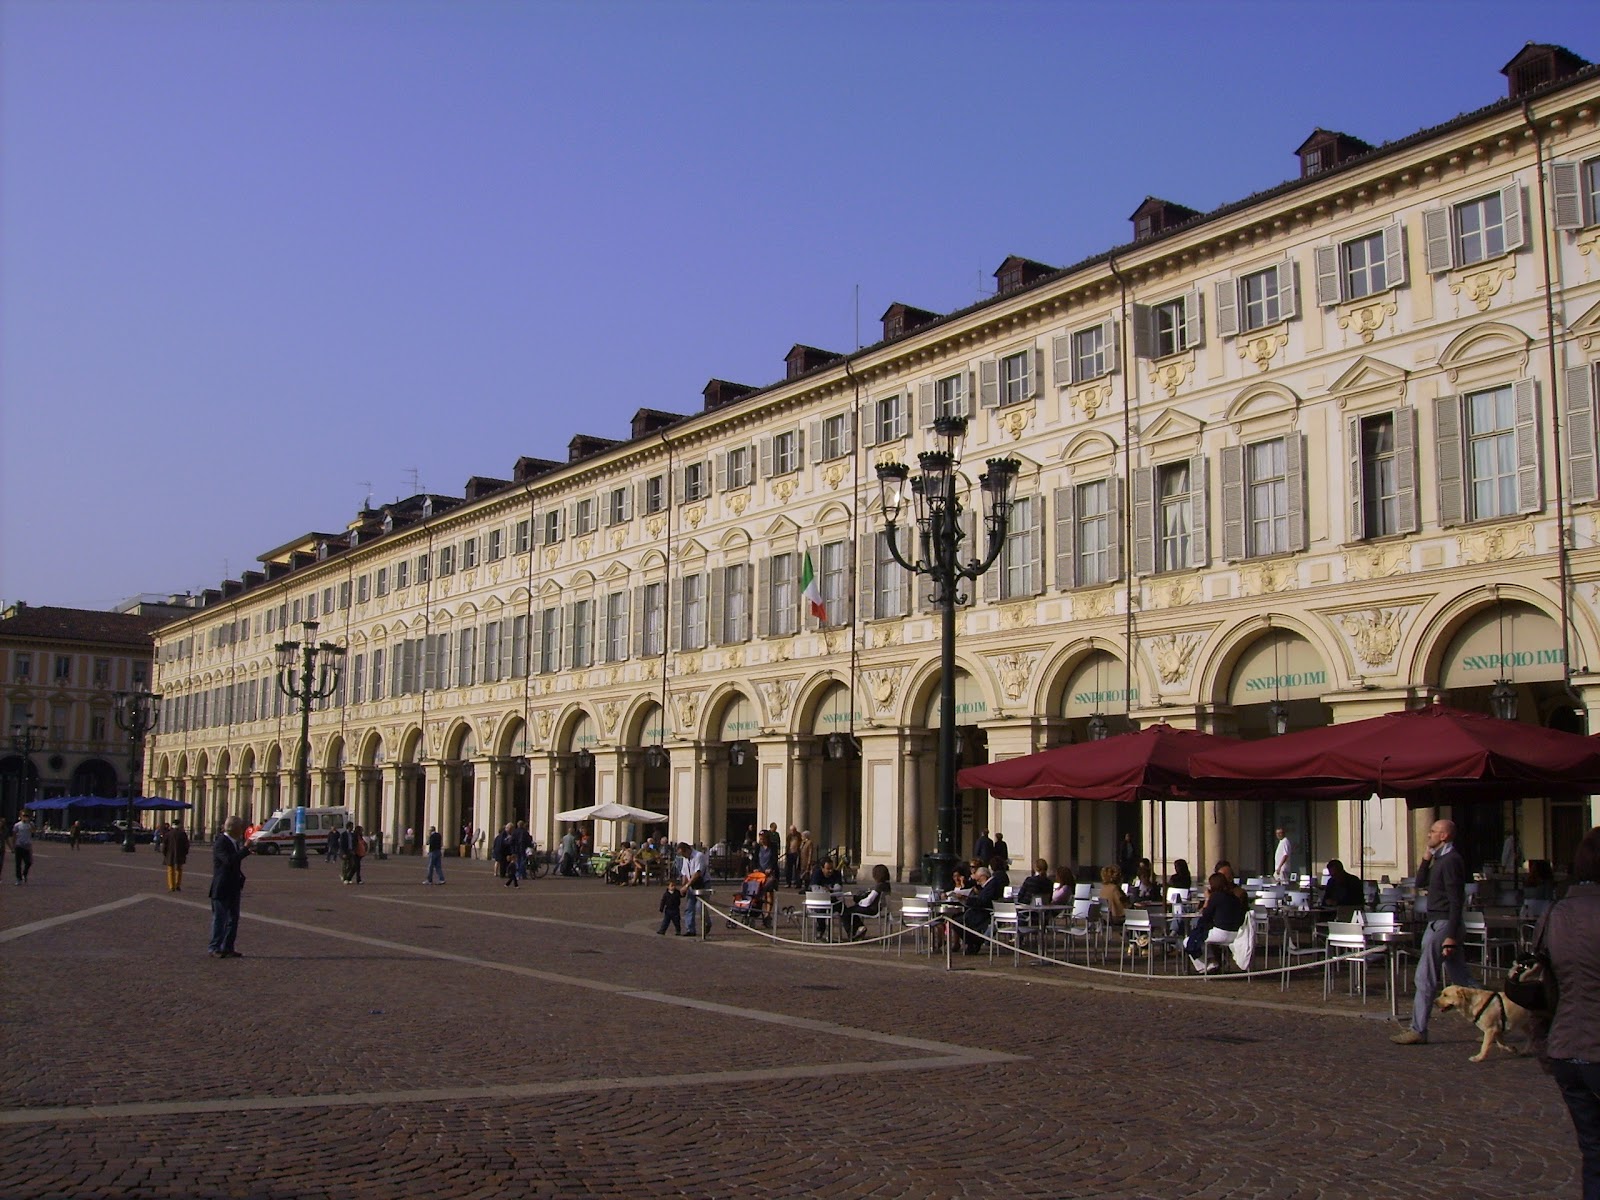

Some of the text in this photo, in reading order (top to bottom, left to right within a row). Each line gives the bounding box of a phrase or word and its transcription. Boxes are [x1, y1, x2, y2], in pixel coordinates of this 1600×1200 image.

[1462, 650, 1535, 671] SANPAOLO
[1245, 670, 1327, 692] SANPAOLO IMI
